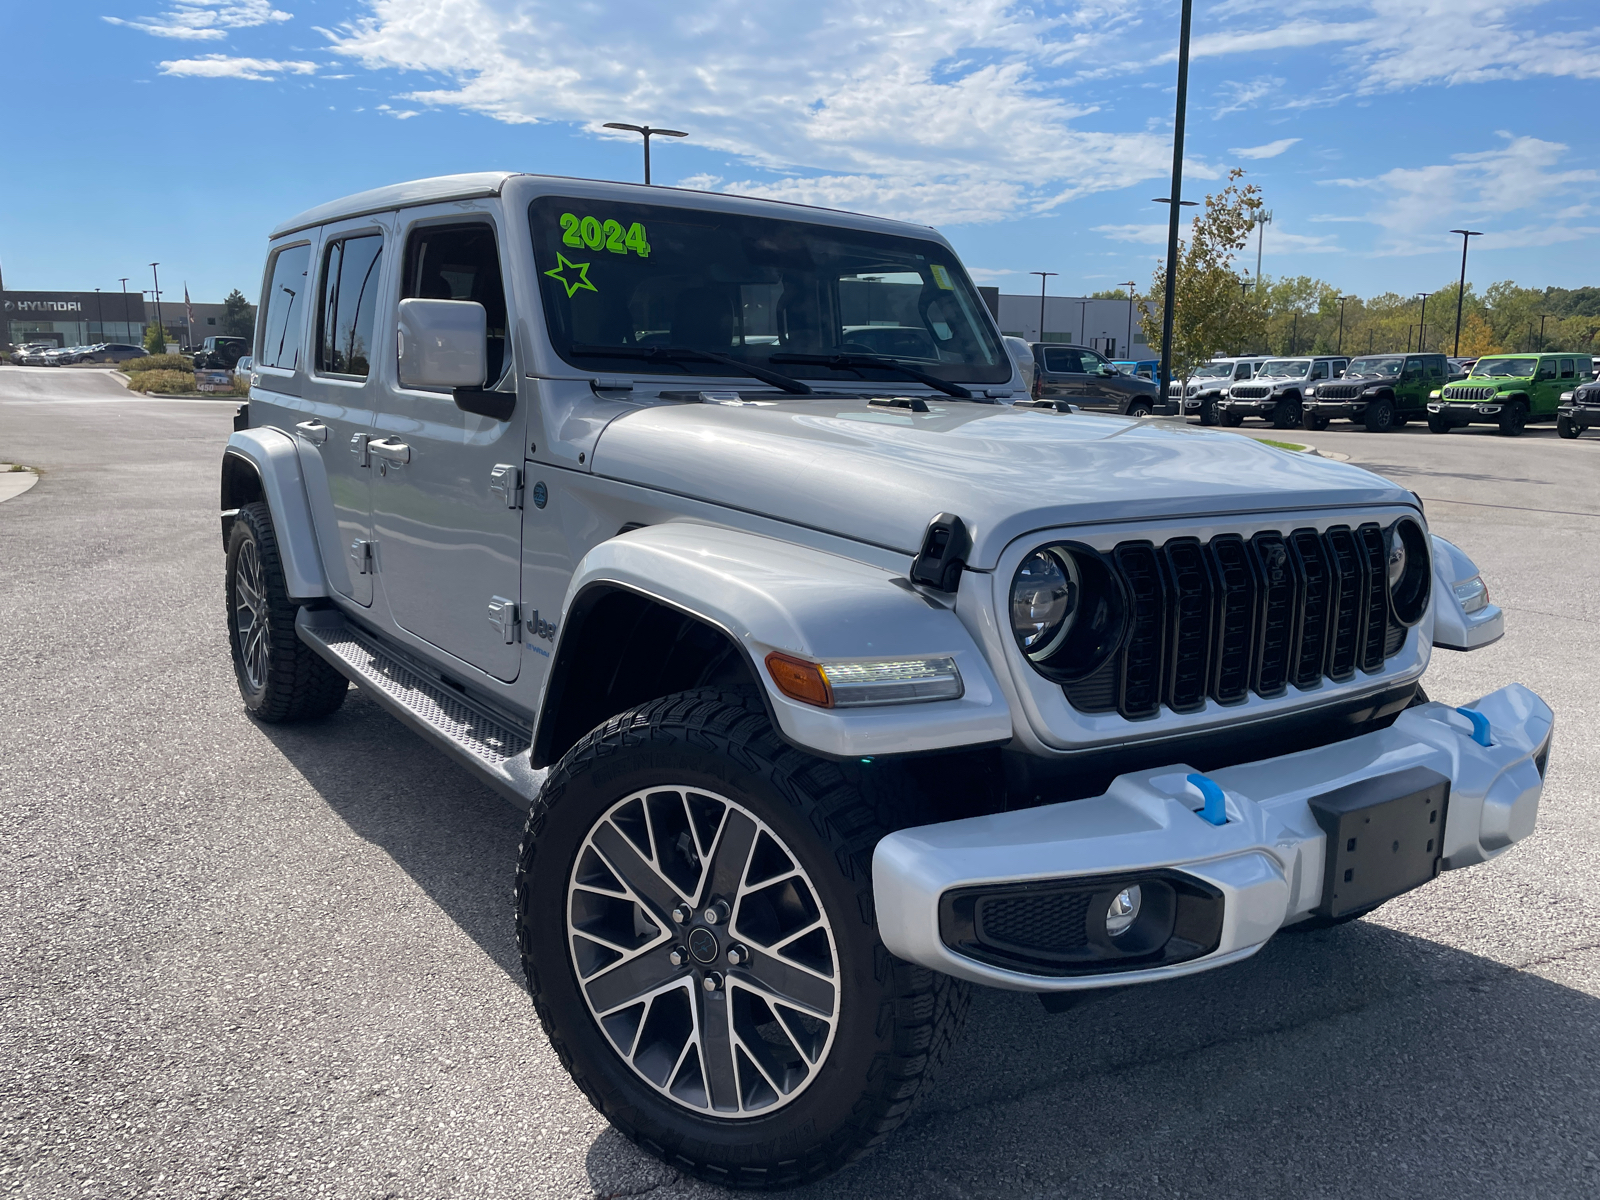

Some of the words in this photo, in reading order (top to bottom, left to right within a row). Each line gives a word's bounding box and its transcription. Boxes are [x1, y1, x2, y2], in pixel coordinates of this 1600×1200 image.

[560, 213, 651, 257] 2024
[18, 301, 82, 312] HYUNDAI
[526, 608, 556, 643] Jee
